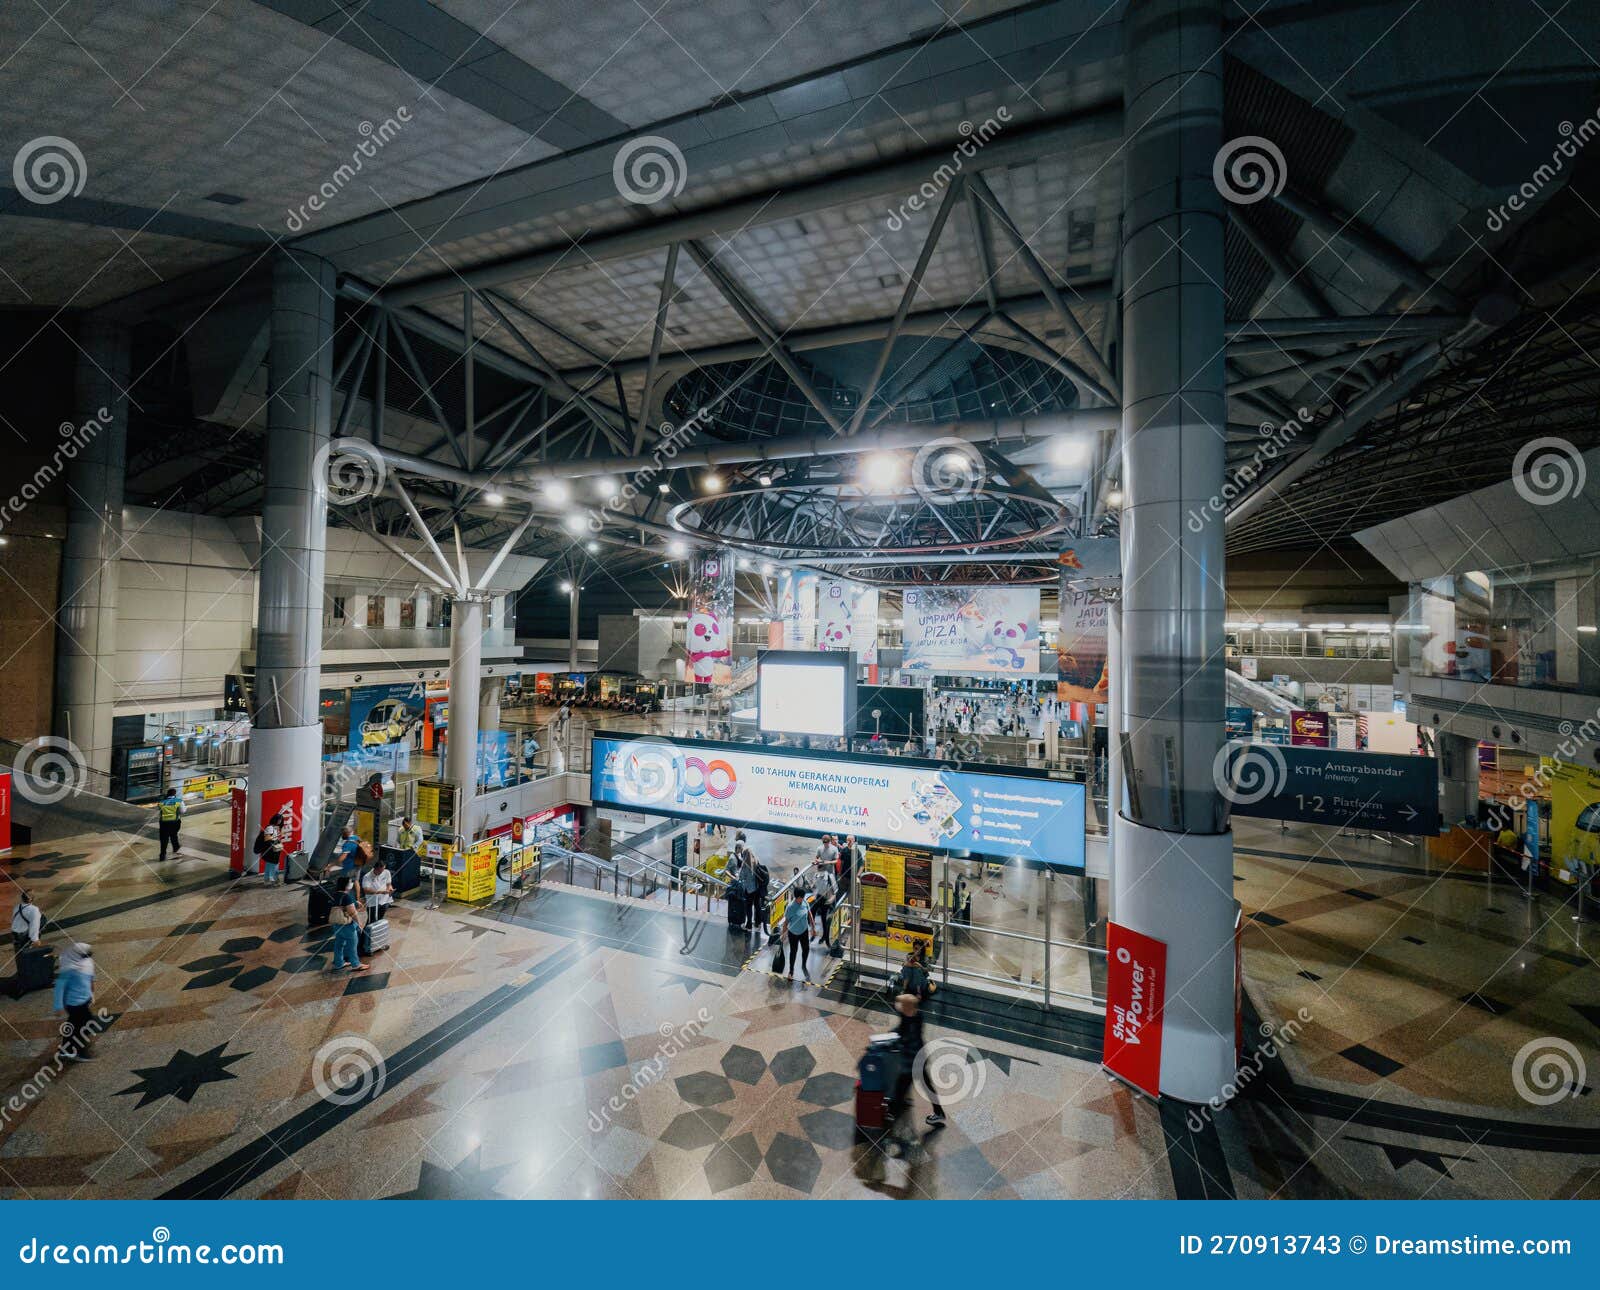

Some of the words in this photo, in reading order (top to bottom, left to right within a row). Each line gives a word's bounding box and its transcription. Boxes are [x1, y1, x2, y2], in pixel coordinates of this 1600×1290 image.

[1073, 591, 1105, 606] PIZ
[918, 613, 963, 626] UMPAMA
[924, 625, 957, 638] PIZA
[751, 766, 765, 775] 100
[767, 767, 796, 779] TAHUN
[799, 771, 842, 783] GERAKAN
[844, 775, 889, 788] KOPERASI
[1295, 765, 1322, 776] KTM
[1325, 762, 1404, 777] Antarabandar
[1325, 773, 1360, 783] Intercity
[788, 781, 847, 794] MEMBANGUN
[767, 796, 817, 811] KELUARGA
[820, 802, 869, 817] MALAYSIA
[1295, 794, 1325, 812] 1-2
[1333, 796, 1383, 810] Platform
[1125, 960, 1145, 1045] V-Power
[1113, 1004, 1125, 1041] Shell
